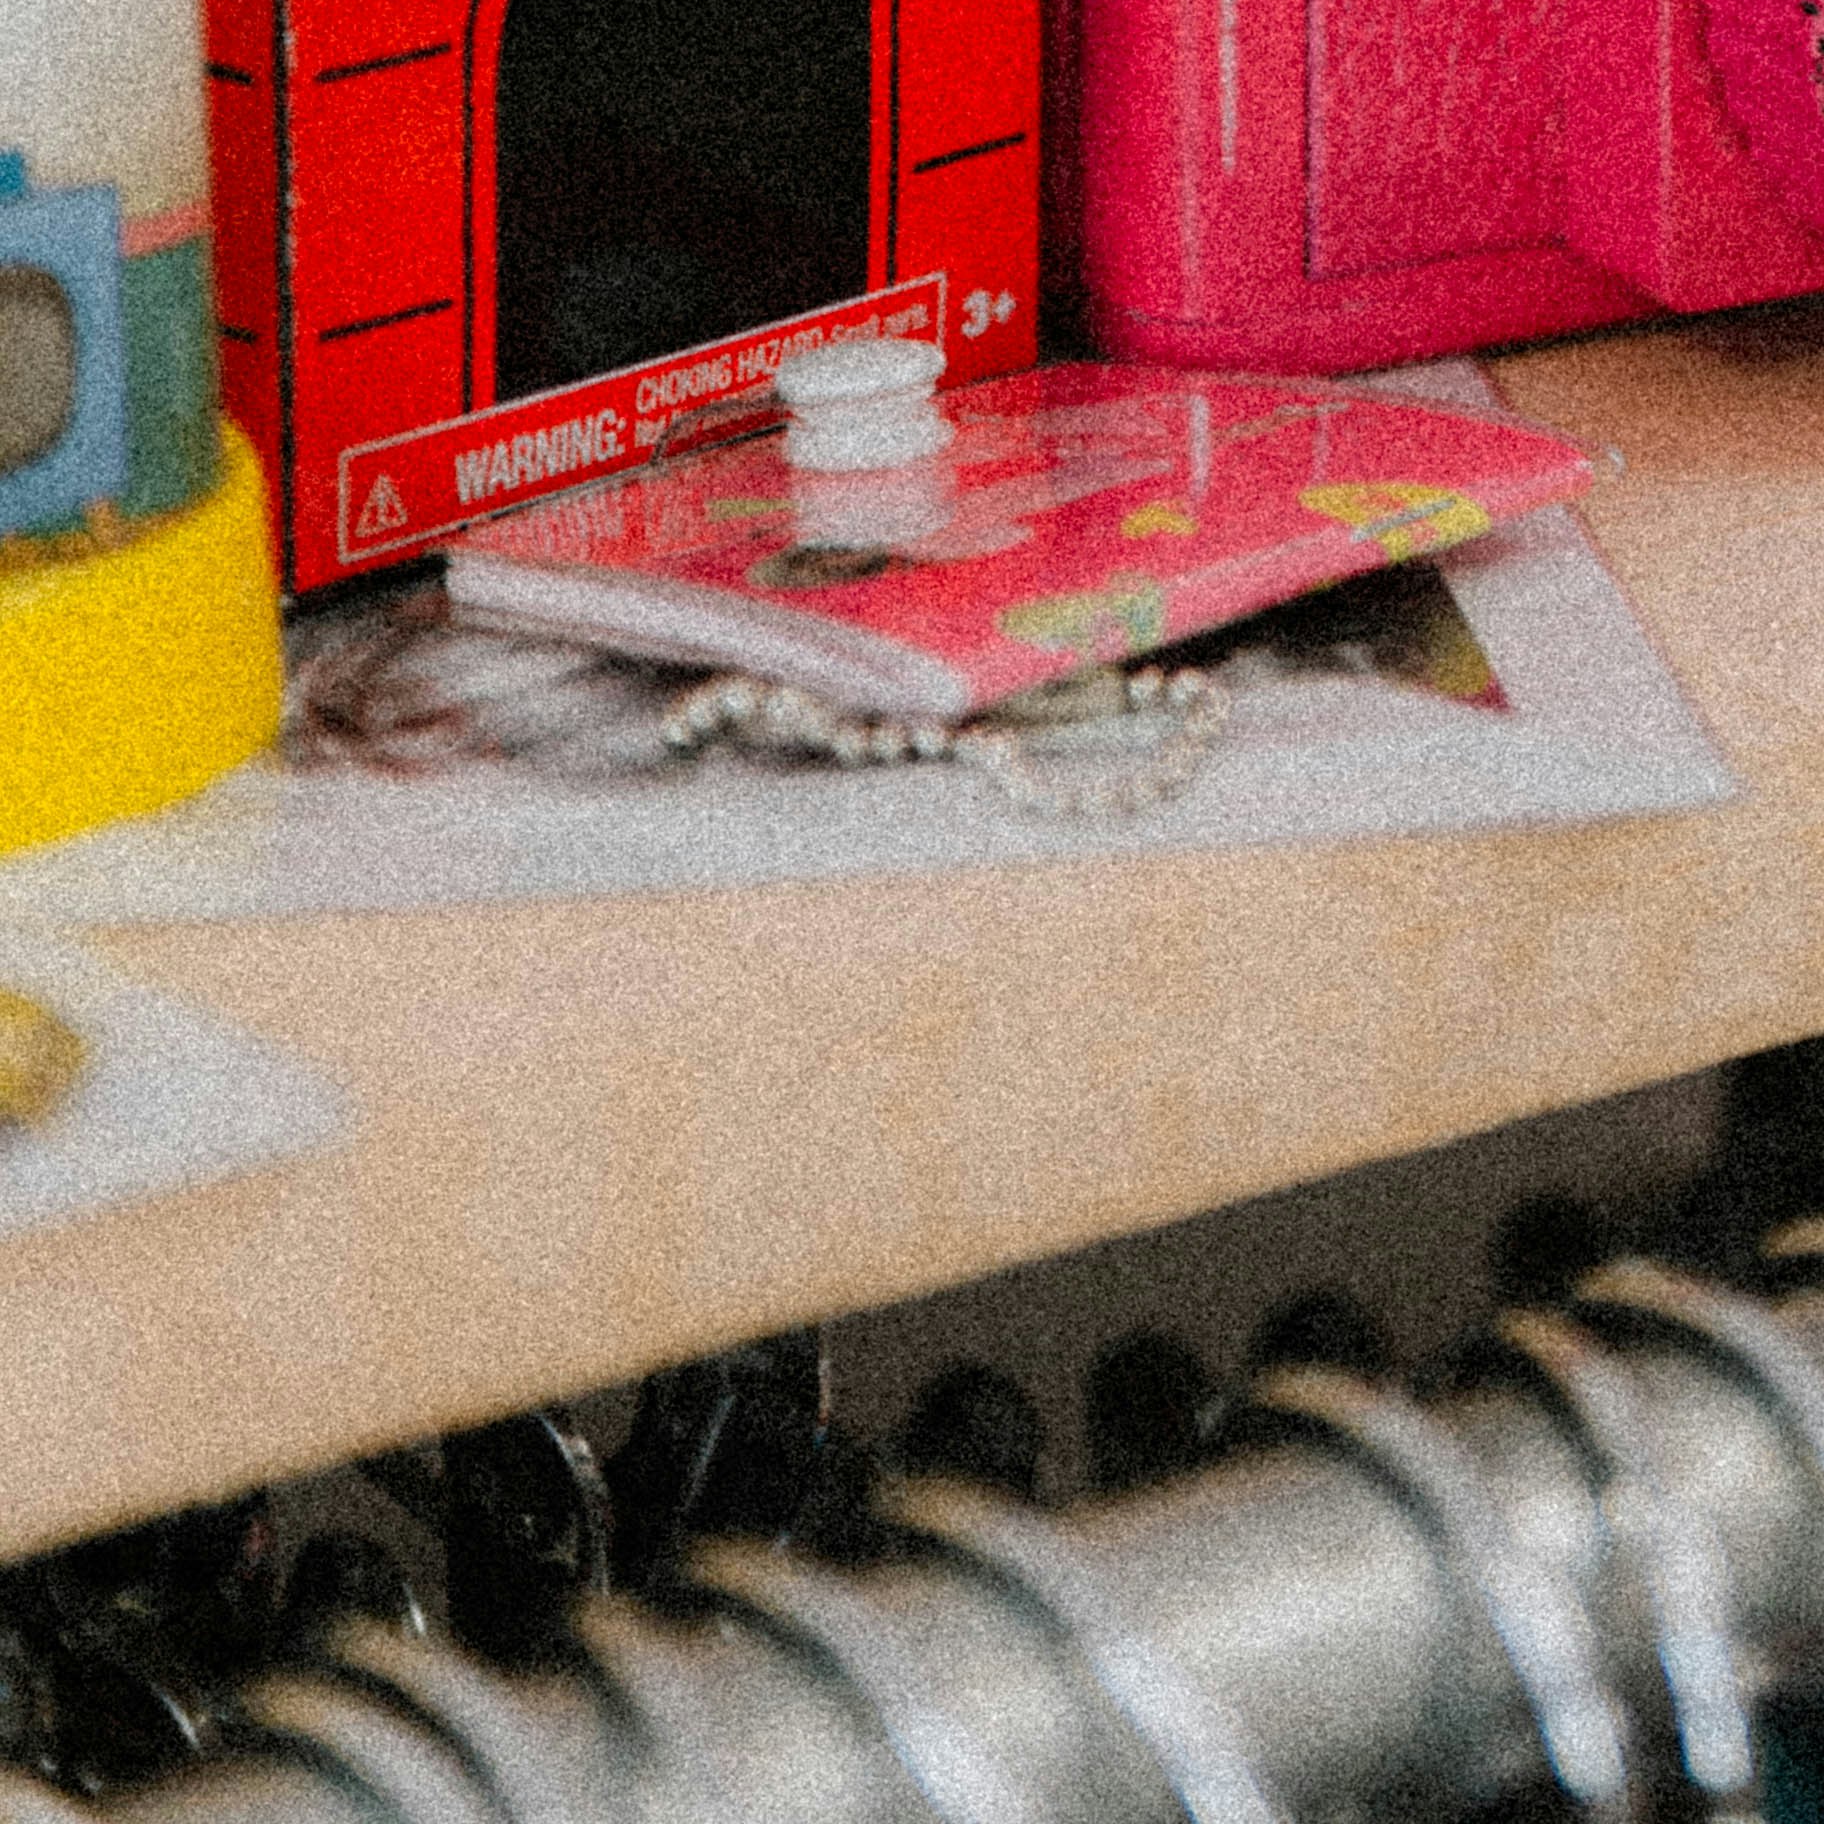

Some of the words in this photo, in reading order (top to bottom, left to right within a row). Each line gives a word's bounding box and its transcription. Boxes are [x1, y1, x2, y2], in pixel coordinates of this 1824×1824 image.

[961, 288, 1016, 339] 3+
[635, 361, 731, 413] CHOKING
[453, 409, 626, 505] WARNING:
